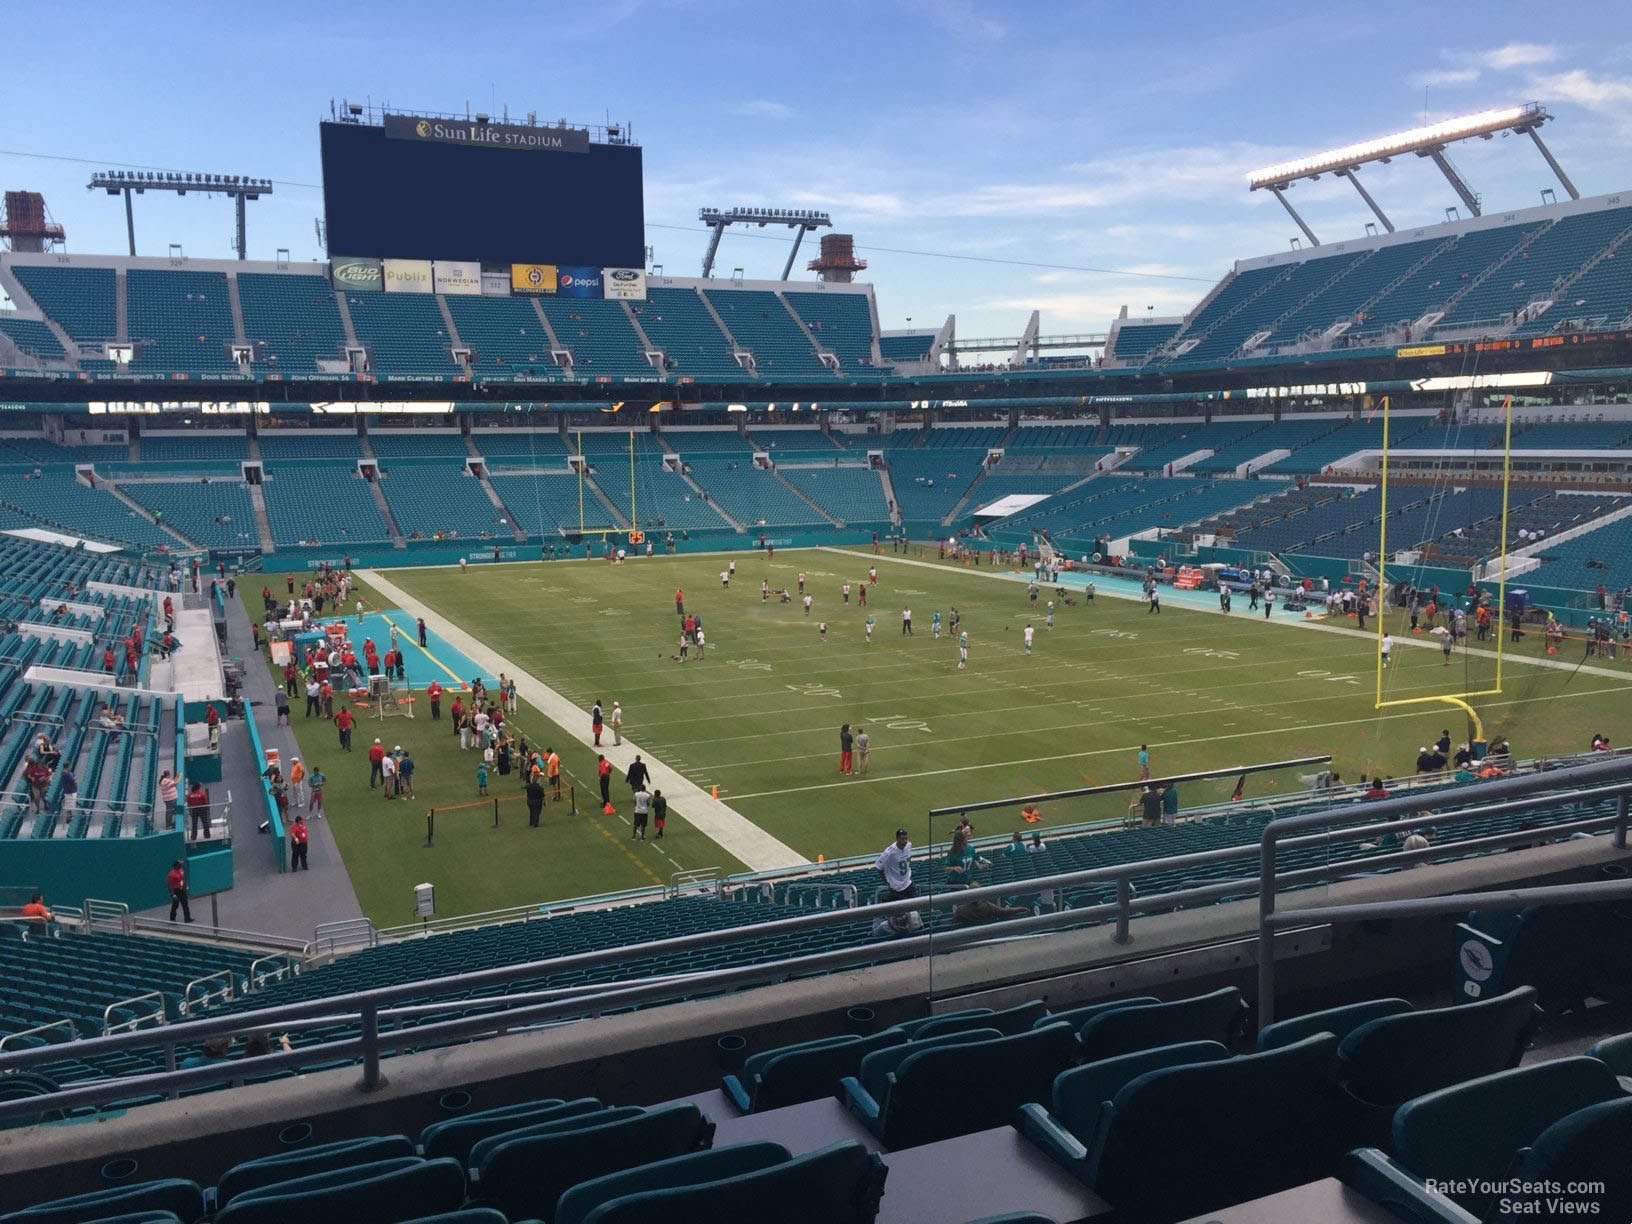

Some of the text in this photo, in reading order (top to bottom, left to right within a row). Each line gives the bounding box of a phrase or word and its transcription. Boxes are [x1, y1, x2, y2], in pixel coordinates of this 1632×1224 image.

[434, 124, 562, 148] Sun Life STADIUM
[1607, 196, 1620, 205] 345
[348, 266, 378, 275] BUD
[341, 272, 381, 281] LIGHT
[387, 271, 427, 282] Publix
[615, 271, 635, 280] Ford
[574, 279, 599, 288] pepsi
[631, 532, 643, 544] 25
